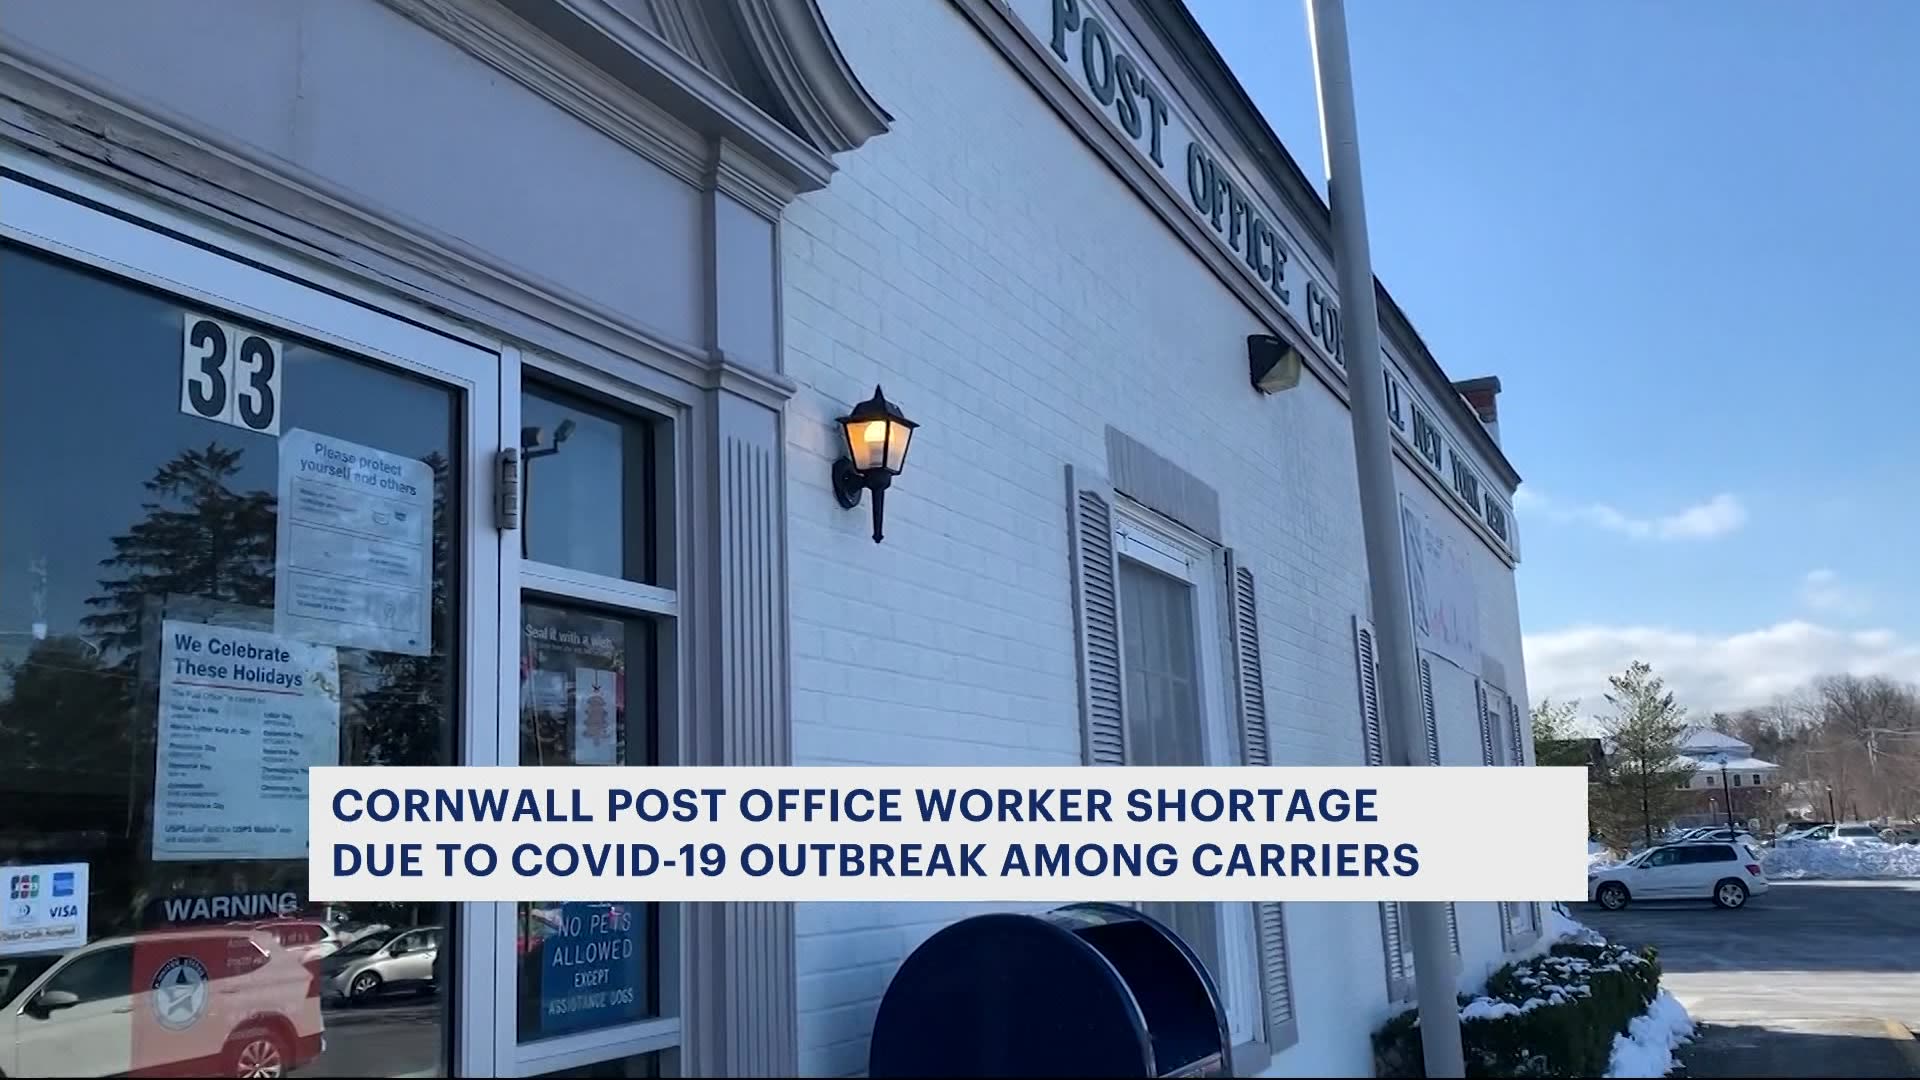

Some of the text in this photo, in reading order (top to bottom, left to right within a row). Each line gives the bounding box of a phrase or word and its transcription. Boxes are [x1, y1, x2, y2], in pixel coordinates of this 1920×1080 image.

[1051, 0, 1168, 169] POST
[1187, 142, 1290, 306] OFFICE
[188, 320, 275, 430] 33
[314, 442, 402, 477] Please protect
[300, 458, 417, 496] yourself and others
[175, 633, 290, 663] We Celebrate
[559, 629, 581, 645] with
[174, 657, 303, 688] These Holidays
[50, 905, 78, 918] VISA
[164, 892, 297, 922] WARNING
[558, 912, 632, 937] NO PETS
[552, 938, 633, 967] ALLOWED
[574, 968, 609, 988] EXCEPT
